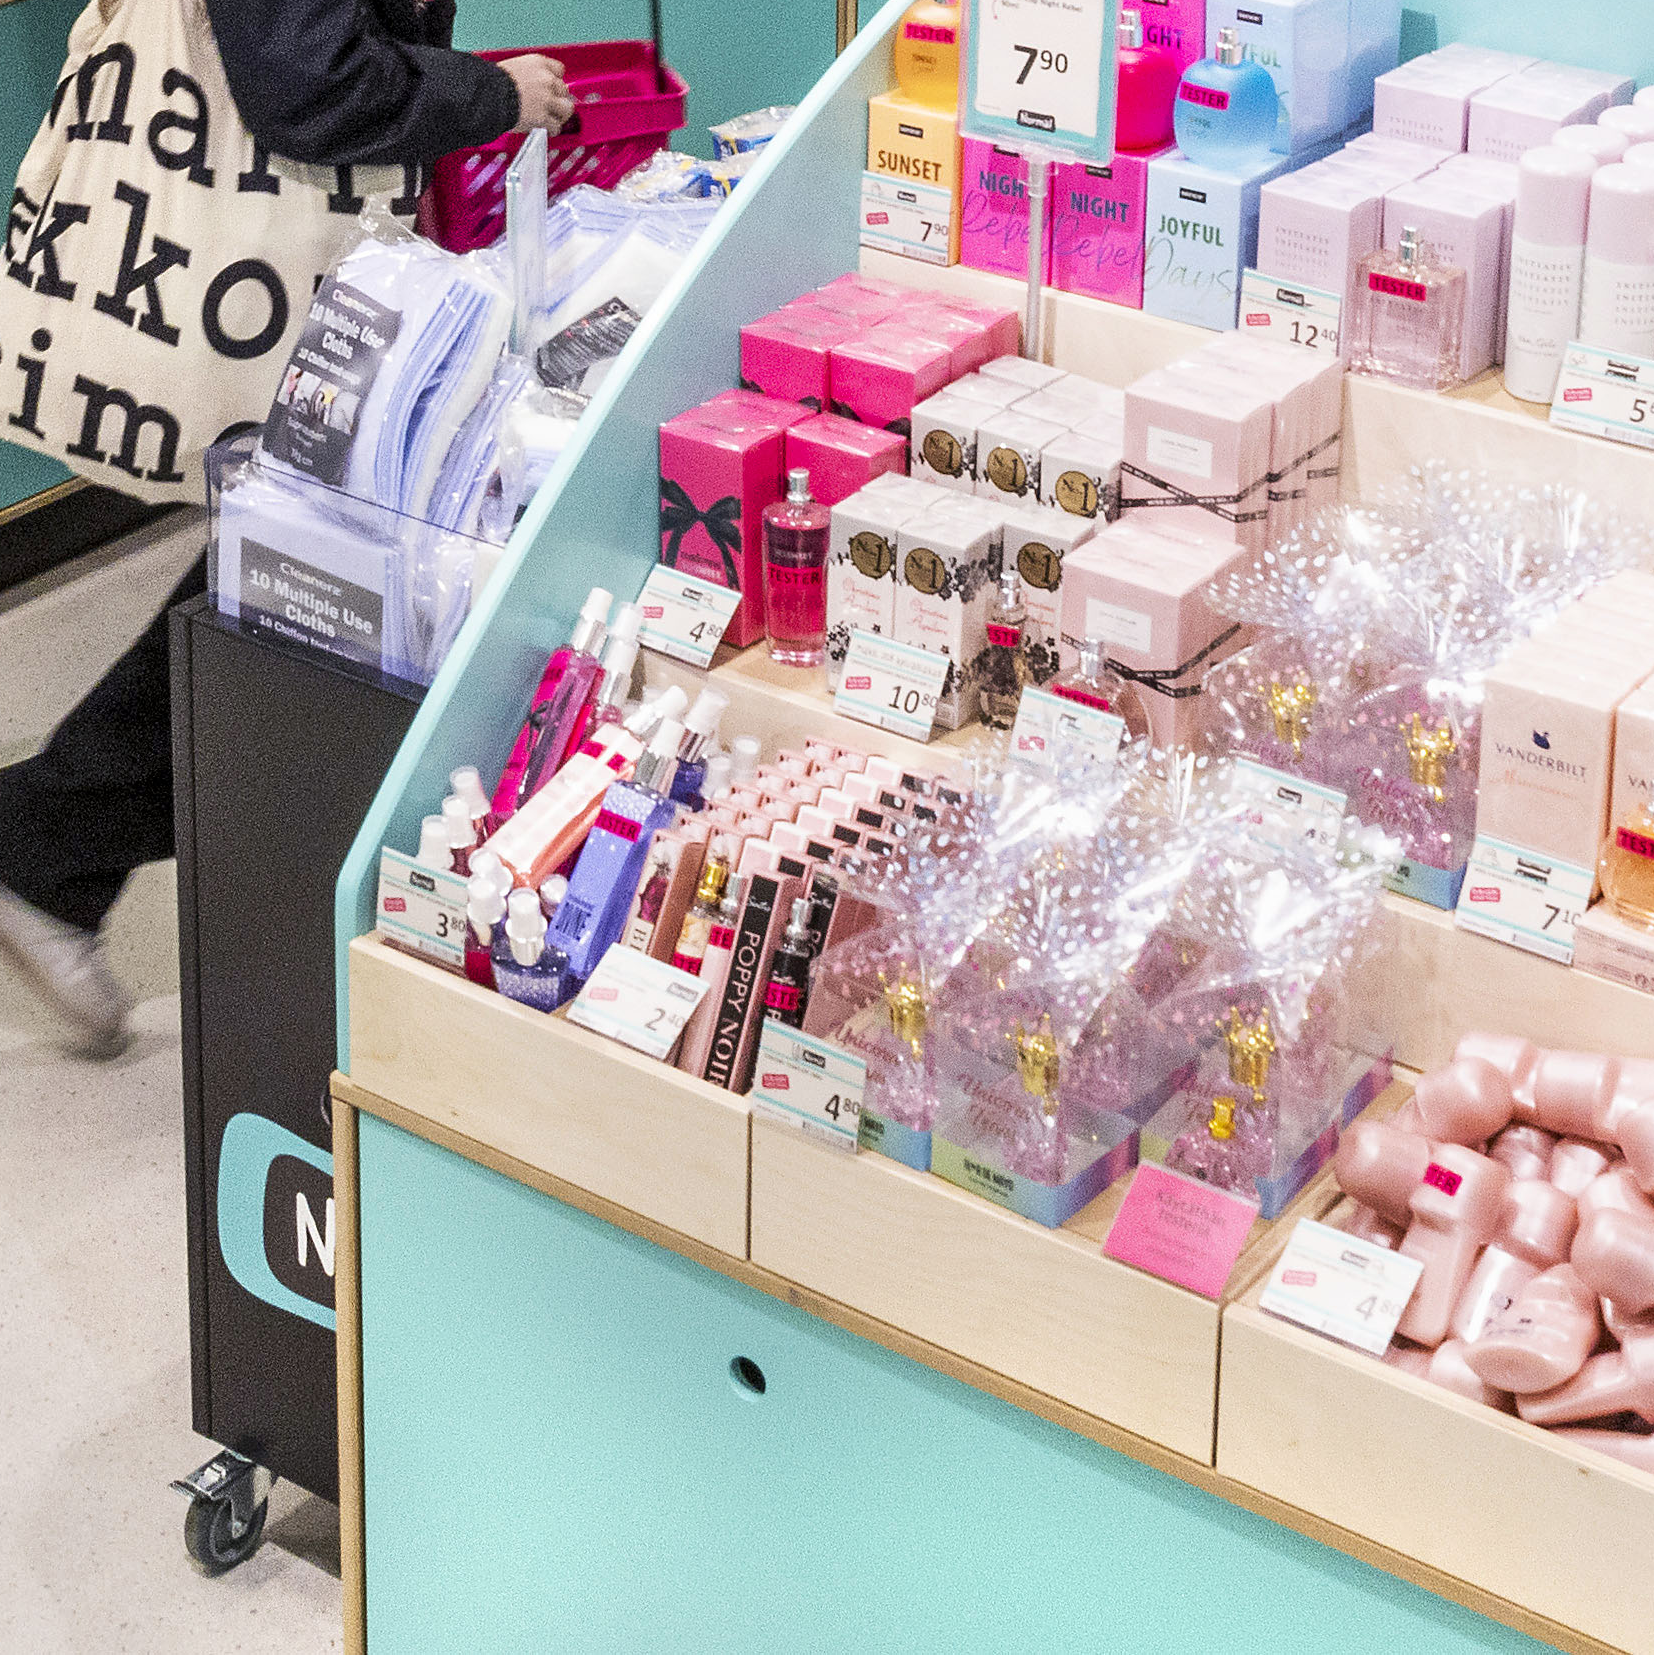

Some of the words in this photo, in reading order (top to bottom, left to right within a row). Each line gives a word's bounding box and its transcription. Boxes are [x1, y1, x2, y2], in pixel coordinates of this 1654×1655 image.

[906, 25, 954, 43] TESTER
[1147, 25, 1183, 49] GHT
[1181, 83, 1226, 109] TESTER
[877, 150, 942, 182] SUNSET
[979, 170, 1025, 199] NIGH
[1070, 192, 1130, 223] NIGHT
[1158, 214, 1225, 248] JOYFUL
[1374, 276, 1425, 299] TESTER
[769, 567, 822, 586] TESTER
[273, 577, 340, 620] Multiple
[342, 607, 373, 635] Use
[283, 604, 337, 639] Cloths
[1495, 742, 1587, 779] VANDERBILT
[730, 931, 761, 1013] POPPY
[705, 1018, 738, 1087] NOIR
